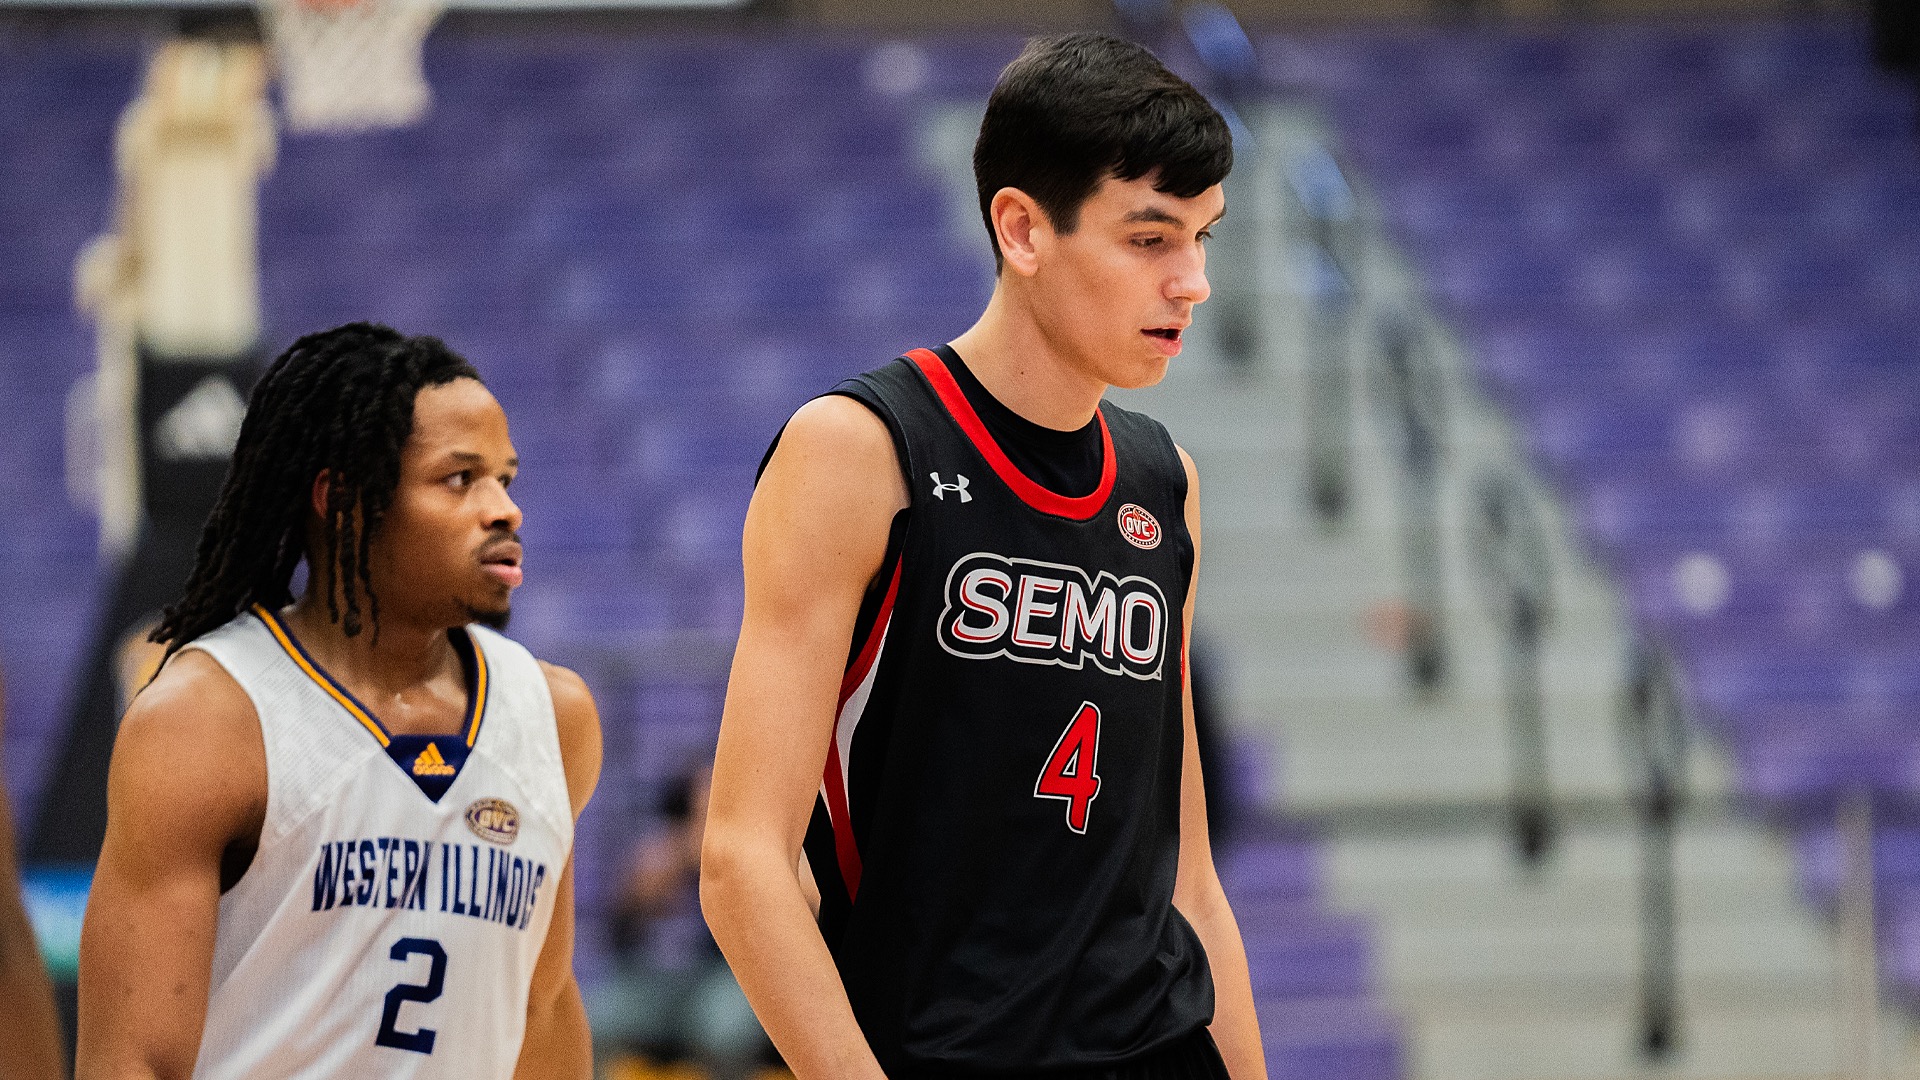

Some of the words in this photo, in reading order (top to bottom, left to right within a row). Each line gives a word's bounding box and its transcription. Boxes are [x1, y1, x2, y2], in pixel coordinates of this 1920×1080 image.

[1126, 516, 1151, 537] OVC
[951, 567, 1161, 664] SEMO
[1033, 700, 1101, 835] 4
[312, 837, 435, 912] WESTERN
[375, 937, 448, 1055] 2
